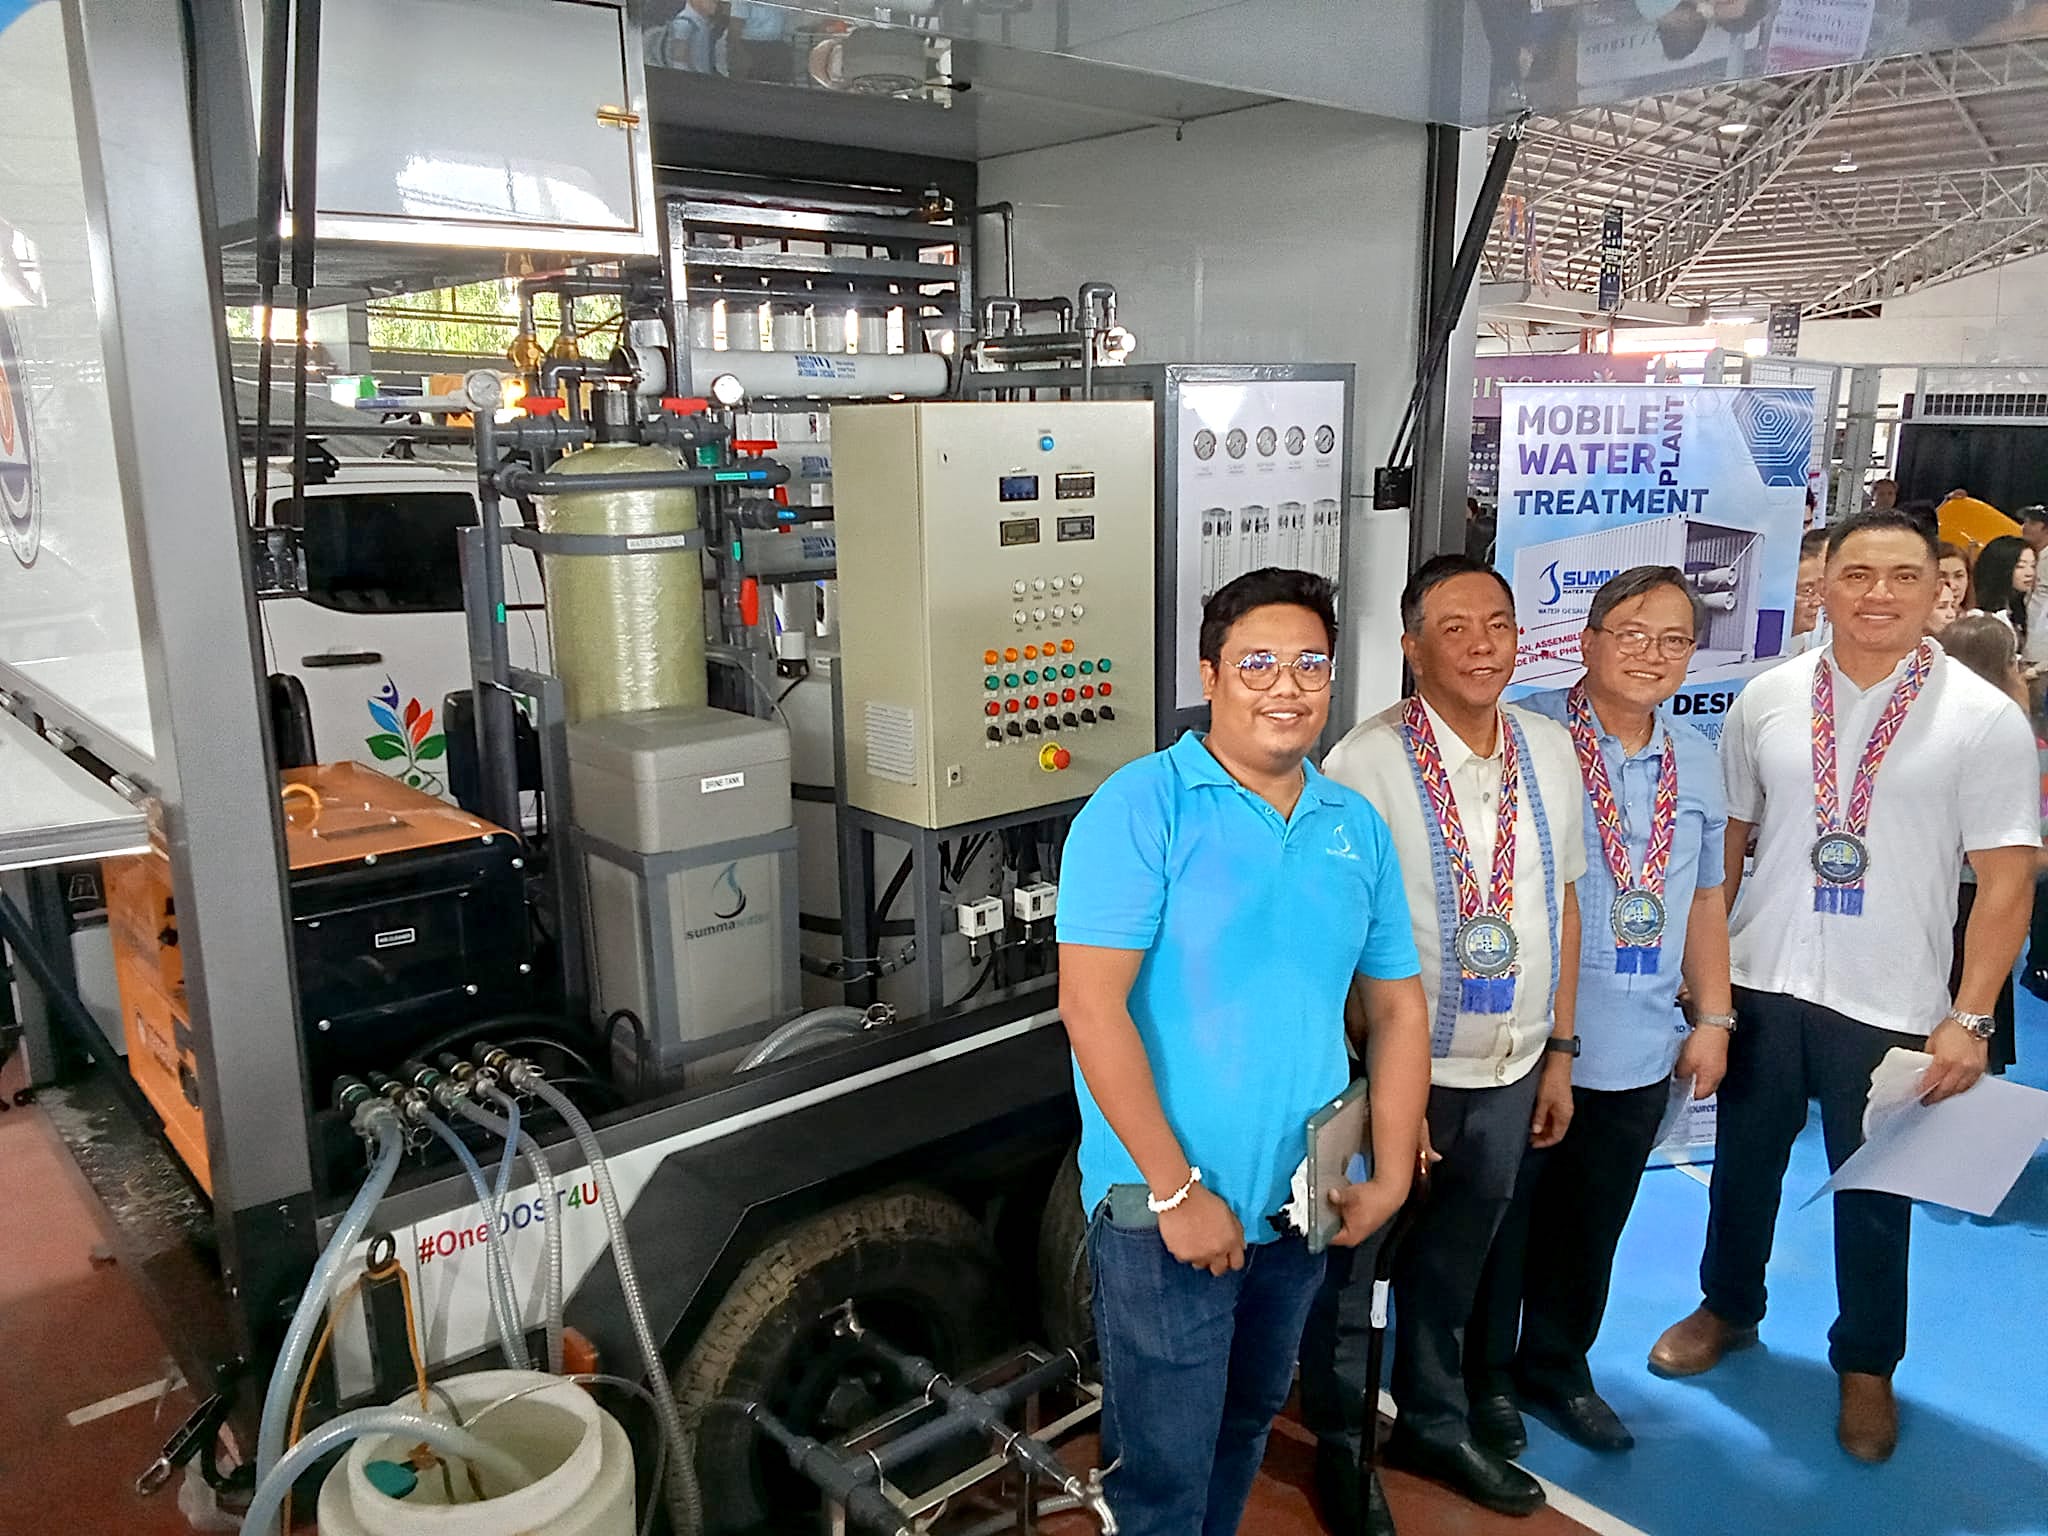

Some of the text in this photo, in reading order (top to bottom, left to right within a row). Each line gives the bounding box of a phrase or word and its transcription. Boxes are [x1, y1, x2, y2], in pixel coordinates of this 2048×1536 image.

[1517, 404, 1660, 436] MOBILE
[1659, 395, 1685, 486] PLANT
[1518, 442, 1656, 475] WATER
[1514, 488, 1709, 516] TREATMENT
